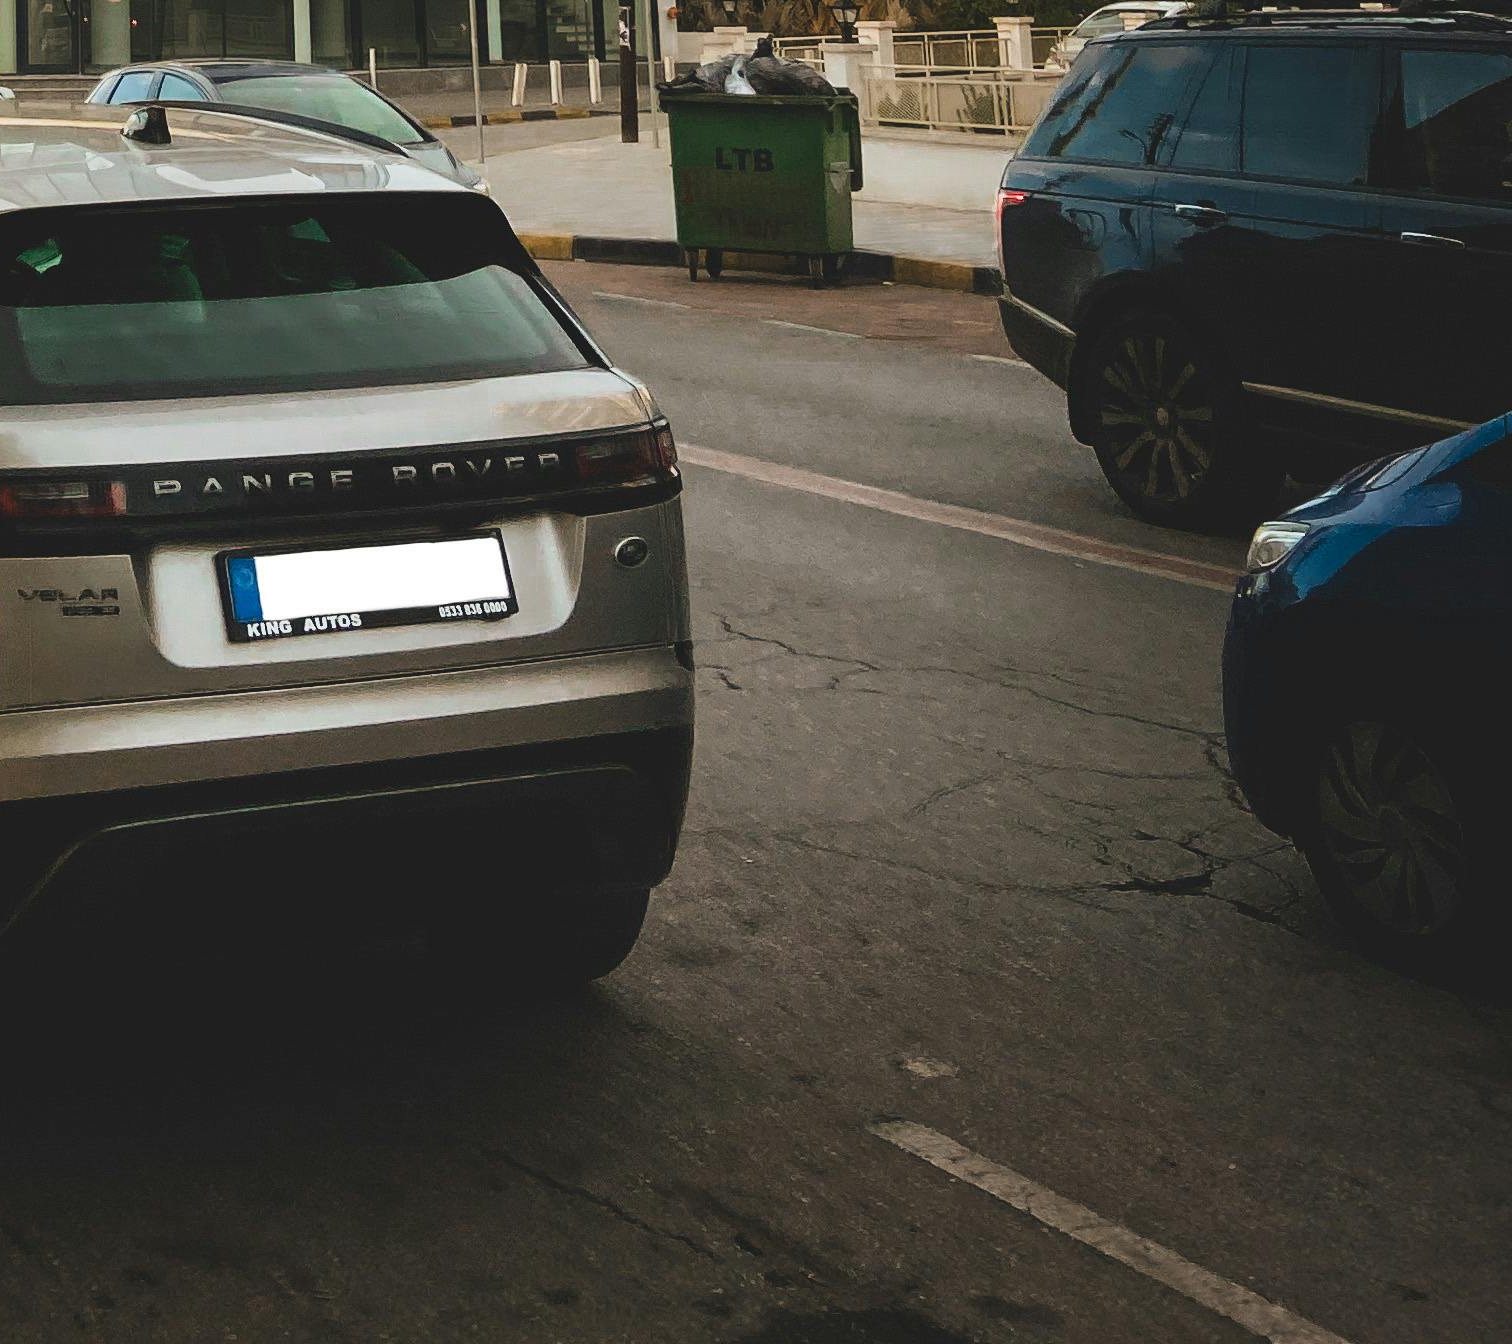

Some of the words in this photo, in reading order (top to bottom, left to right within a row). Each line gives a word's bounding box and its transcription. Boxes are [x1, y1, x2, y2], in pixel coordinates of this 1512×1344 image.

[714, 146, 776, 172] LTB
[152, 469, 354, 500] RANGE
[247, 619, 293, 638] KING
[303, 613, 363, 632] AUTOS
[438, 604, 464, 618] 0533
[482, 600, 508, 614] 0000
